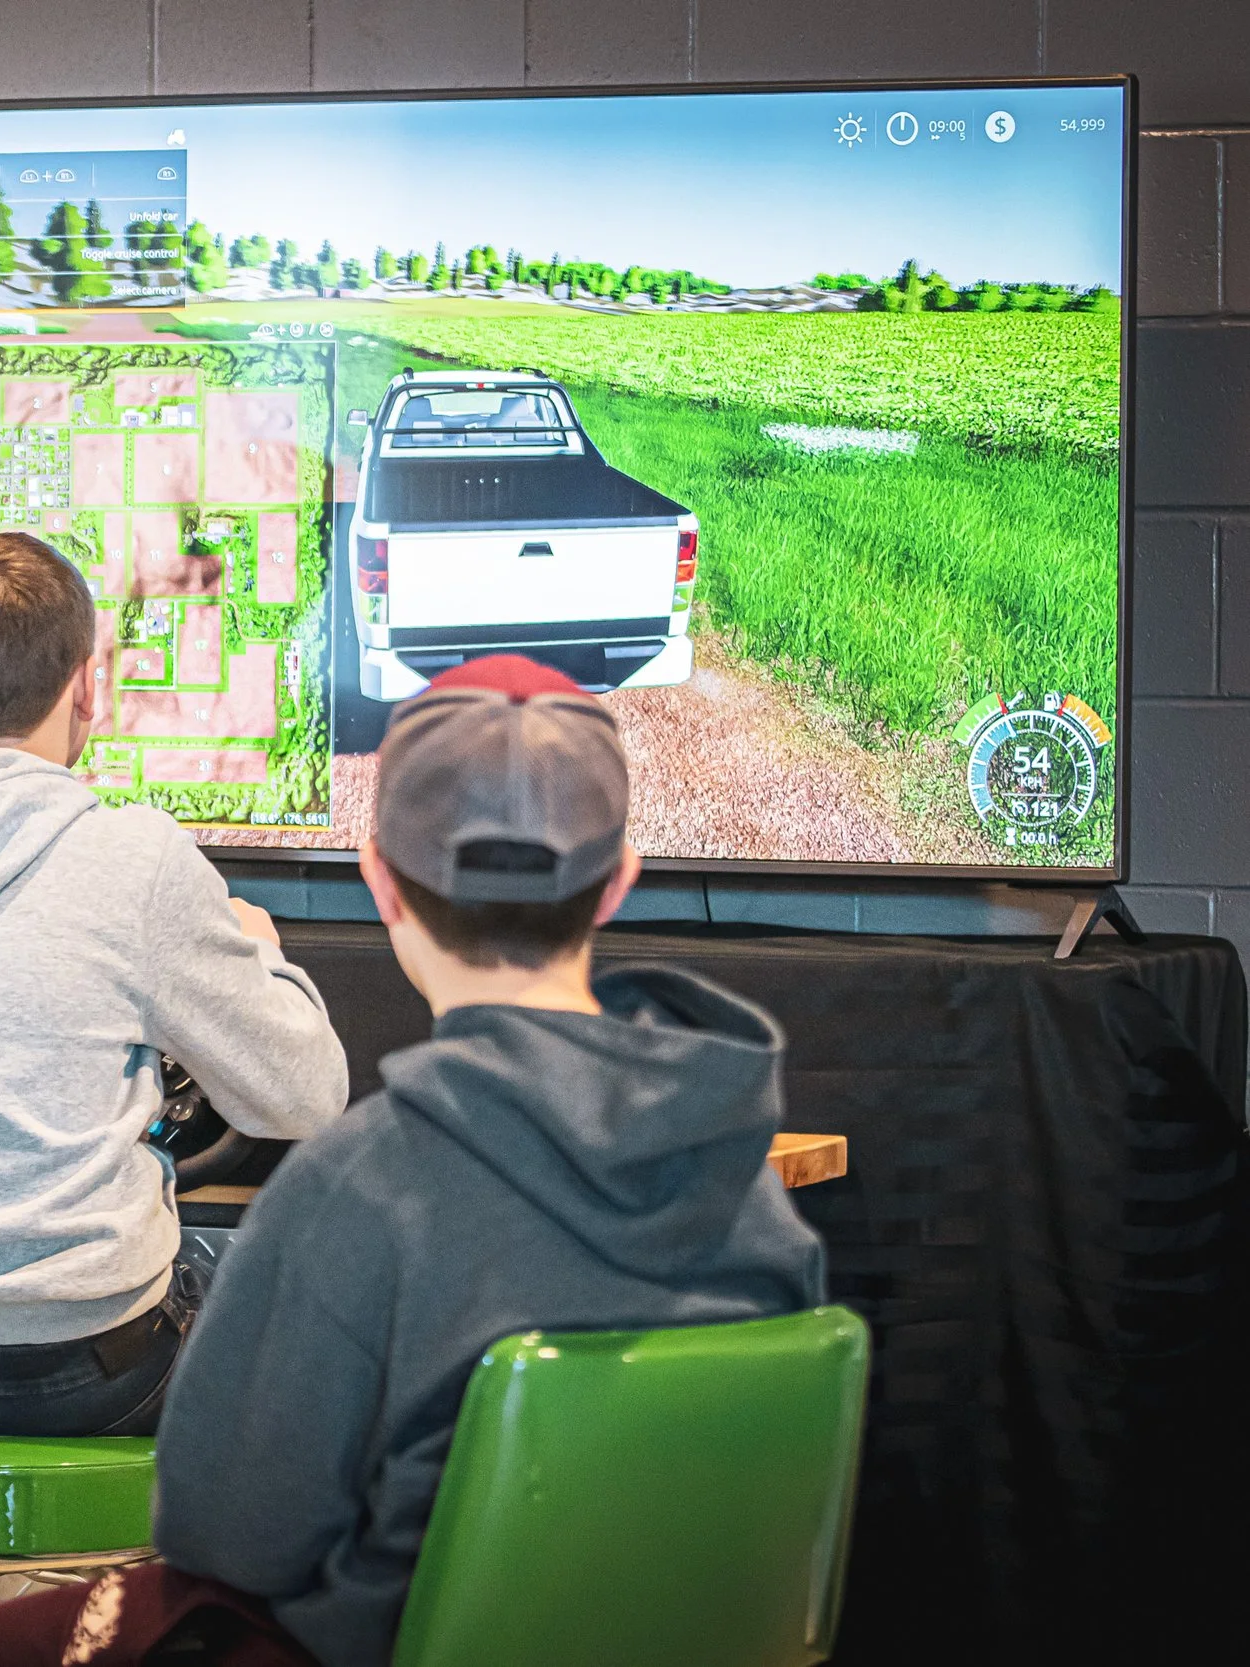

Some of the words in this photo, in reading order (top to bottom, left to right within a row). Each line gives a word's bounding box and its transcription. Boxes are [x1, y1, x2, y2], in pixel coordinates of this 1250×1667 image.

[928, 119, 966, 133] 09:00
[1059, 118, 1106, 132] 54,999
[130, 211, 161, 221] Unfold
[163, 212, 179, 221] car
[81, 249, 111, 260] Toggle
[114, 249, 142, 259] cruise
[144, 248, 179, 258] control
[112, 286, 141, 295] Select
[142, 286, 177, 295] camera
[33, 398, 43, 409] 2
[248, 442, 257, 454] 9
[110, 550, 122, 561] 10
[150, 549, 161, 560] 11
[1013, 745, 1051, 775] 54
[1020, 775, 1043, 789] KPH
[1031, 799, 1059, 817] 121
